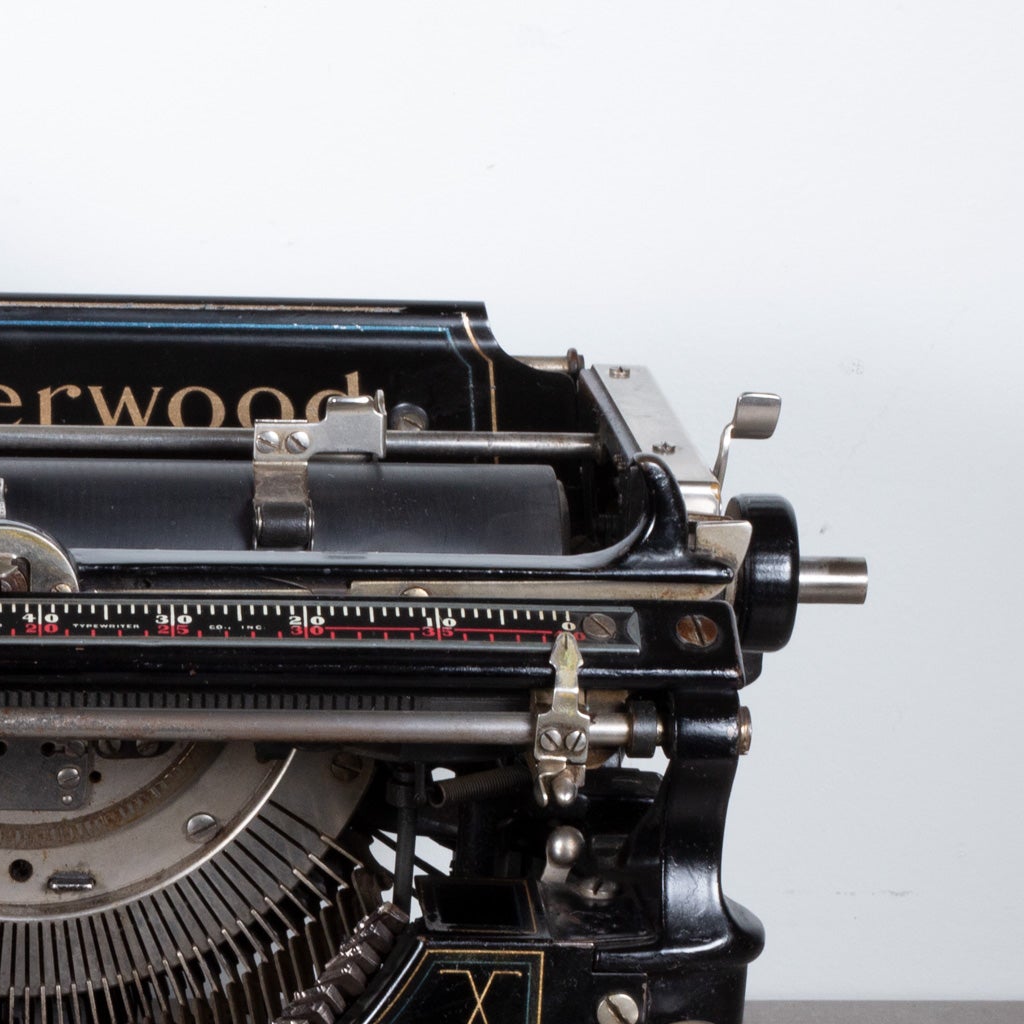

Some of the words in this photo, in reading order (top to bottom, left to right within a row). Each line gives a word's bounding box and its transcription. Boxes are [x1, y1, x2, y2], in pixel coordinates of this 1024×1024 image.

[22, 613, 59, 623] 40
[155, 614, 193, 625] 30
[289, 615, 325, 626] 20
